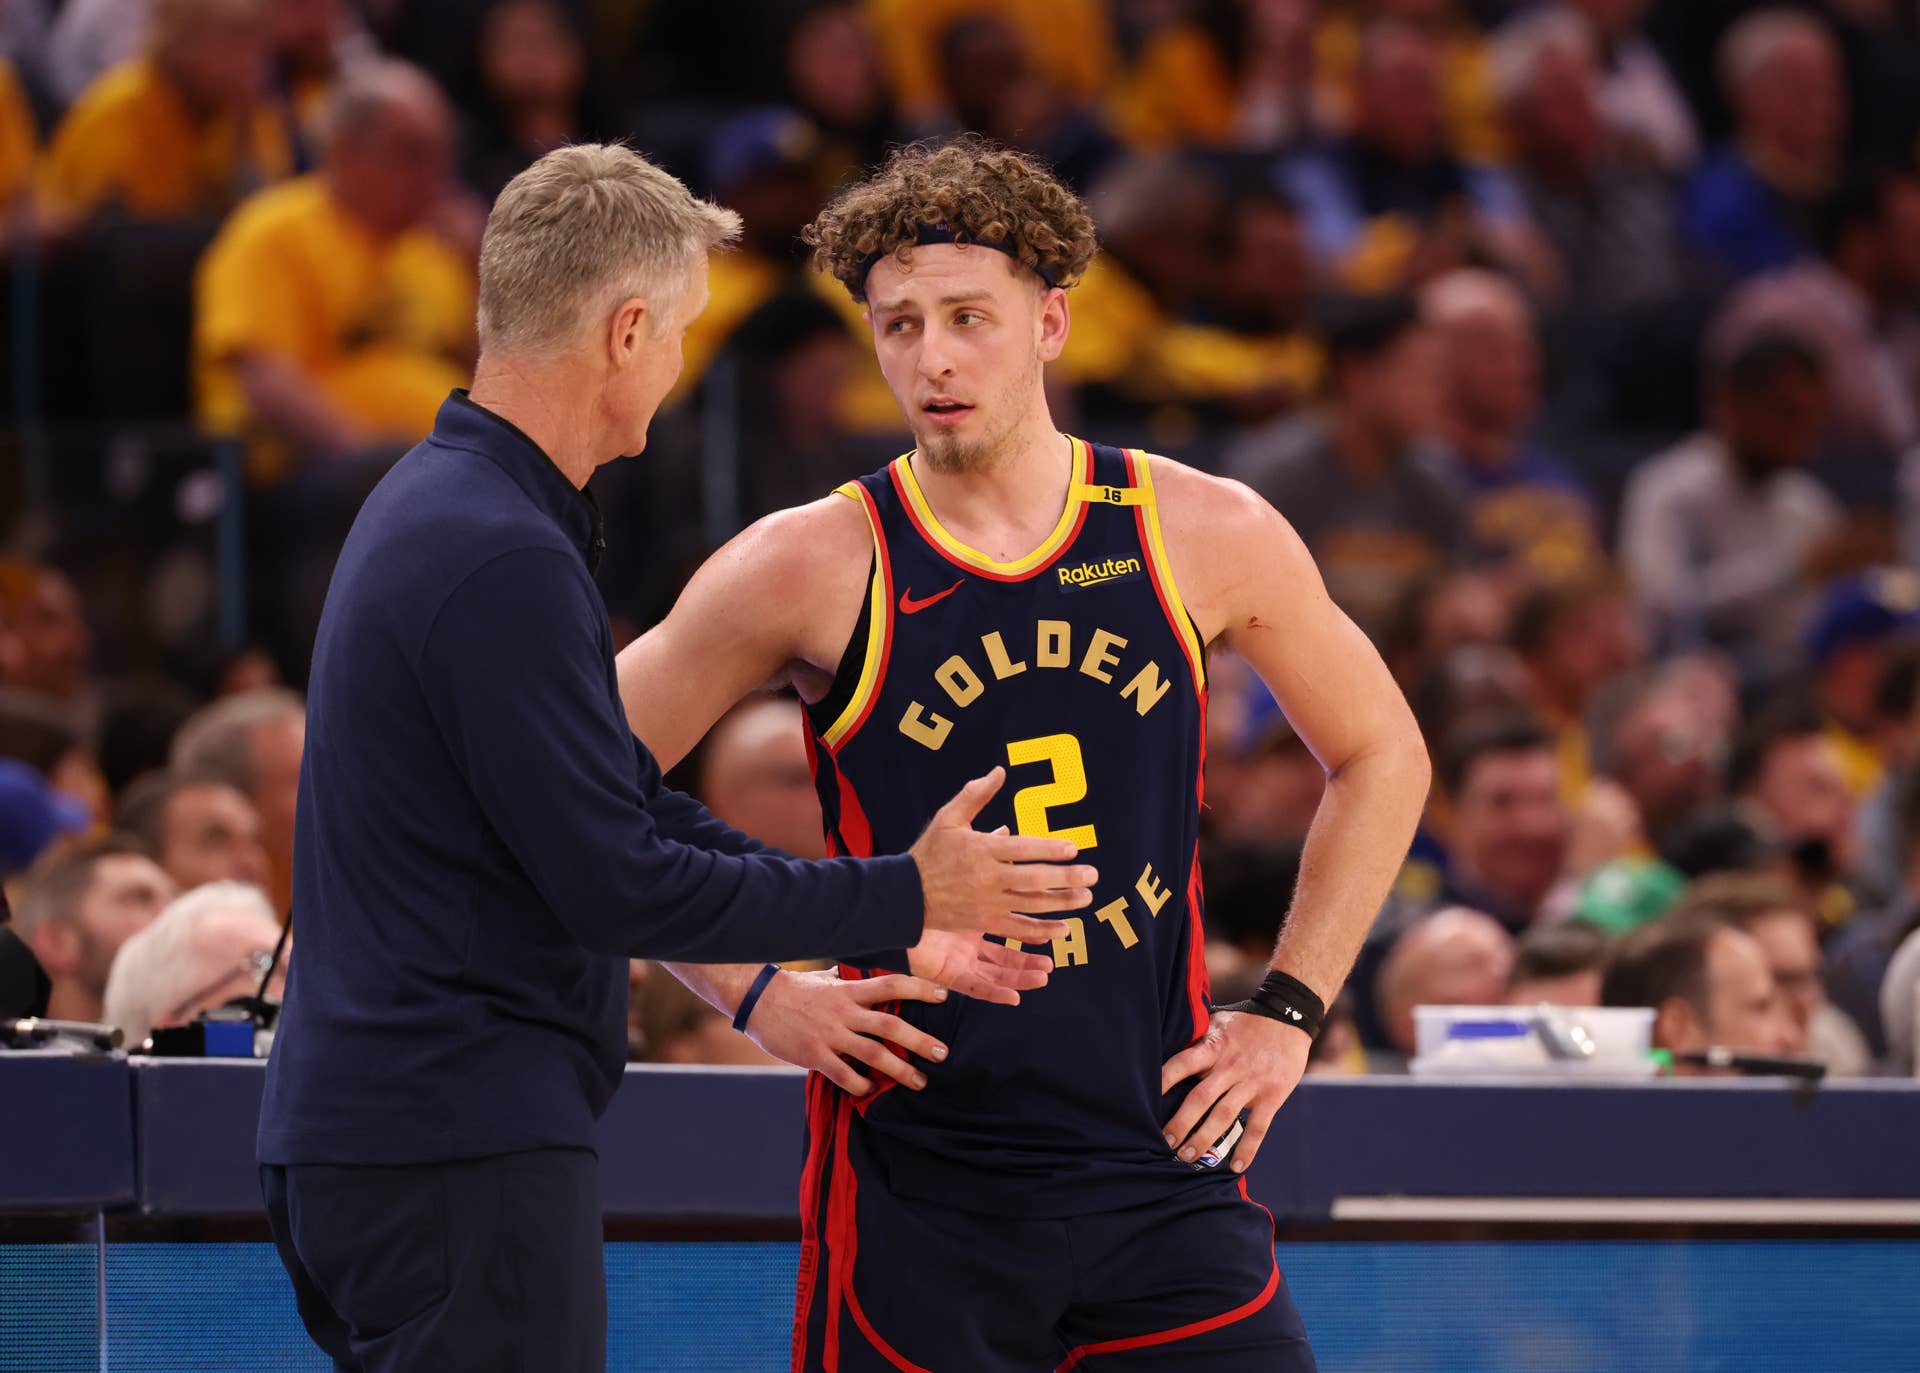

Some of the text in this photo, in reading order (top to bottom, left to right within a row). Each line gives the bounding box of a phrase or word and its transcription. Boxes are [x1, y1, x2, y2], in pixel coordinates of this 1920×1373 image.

[1103, 487, 1122, 503] 16
[1058, 557, 1141, 586] Rakuten
[898, 619, 1172, 751] GOLDEN
[1006, 733, 1098, 851] 2
